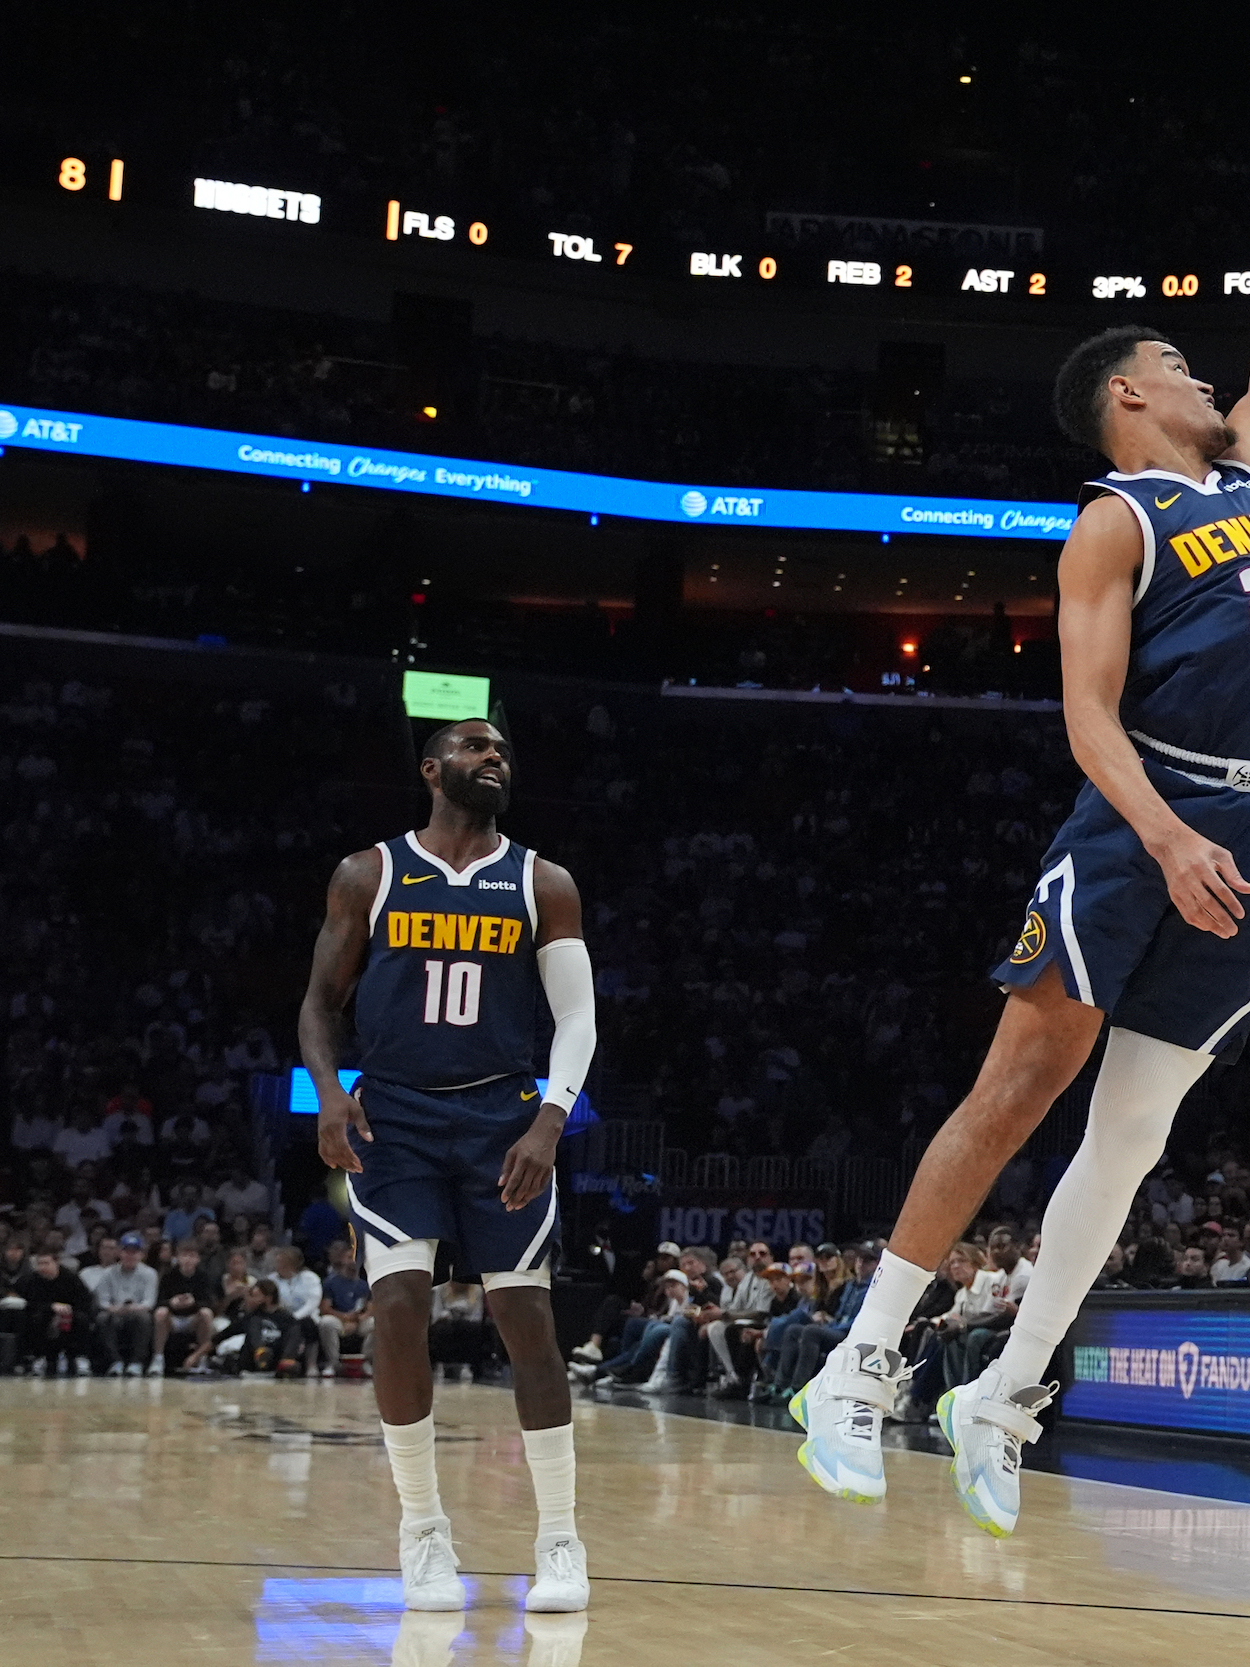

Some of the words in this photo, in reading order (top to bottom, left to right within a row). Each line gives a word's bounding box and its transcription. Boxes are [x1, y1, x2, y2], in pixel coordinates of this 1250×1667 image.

[58, 157, 87, 192] 8
[402, 211, 456, 242] FLS
[468, 222, 489, 246] 0
[547, 232, 603, 263] TOL
[614, 243, 634, 266] 7
[690, 252, 743, 279] BLK
[758, 257, 778, 281] 0
[827, 260, 883, 287] REB
[895, 265, 914, 289] 2
[961, 269, 1016, 294] AST
[1028, 273, 1048, 297] 2
[1092, 276, 1148, 300] 3P%
[1162, 274, 1200, 298] 0.0
[21, 417, 84, 443] AT&T
[238, 444, 342, 475] Connecting
[347, 455, 428, 484] Changes
[434, 467, 532, 496] Everything
[711, 496, 763, 517] AT&T
[901, 506, 995, 529] Connecting
[478, 878, 518, 893] ibotta
[387, 911, 524, 955] DENVER
[424, 960, 483, 1027] 10
[660, 1207, 730, 1246] HOT
[734, 1207, 826, 1247] SEATS
[1109, 1348, 1130, 1384] THE
[1130, 1349, 1159, 1386] HEAT
[1159, 1349, 1177, 1388] ON
